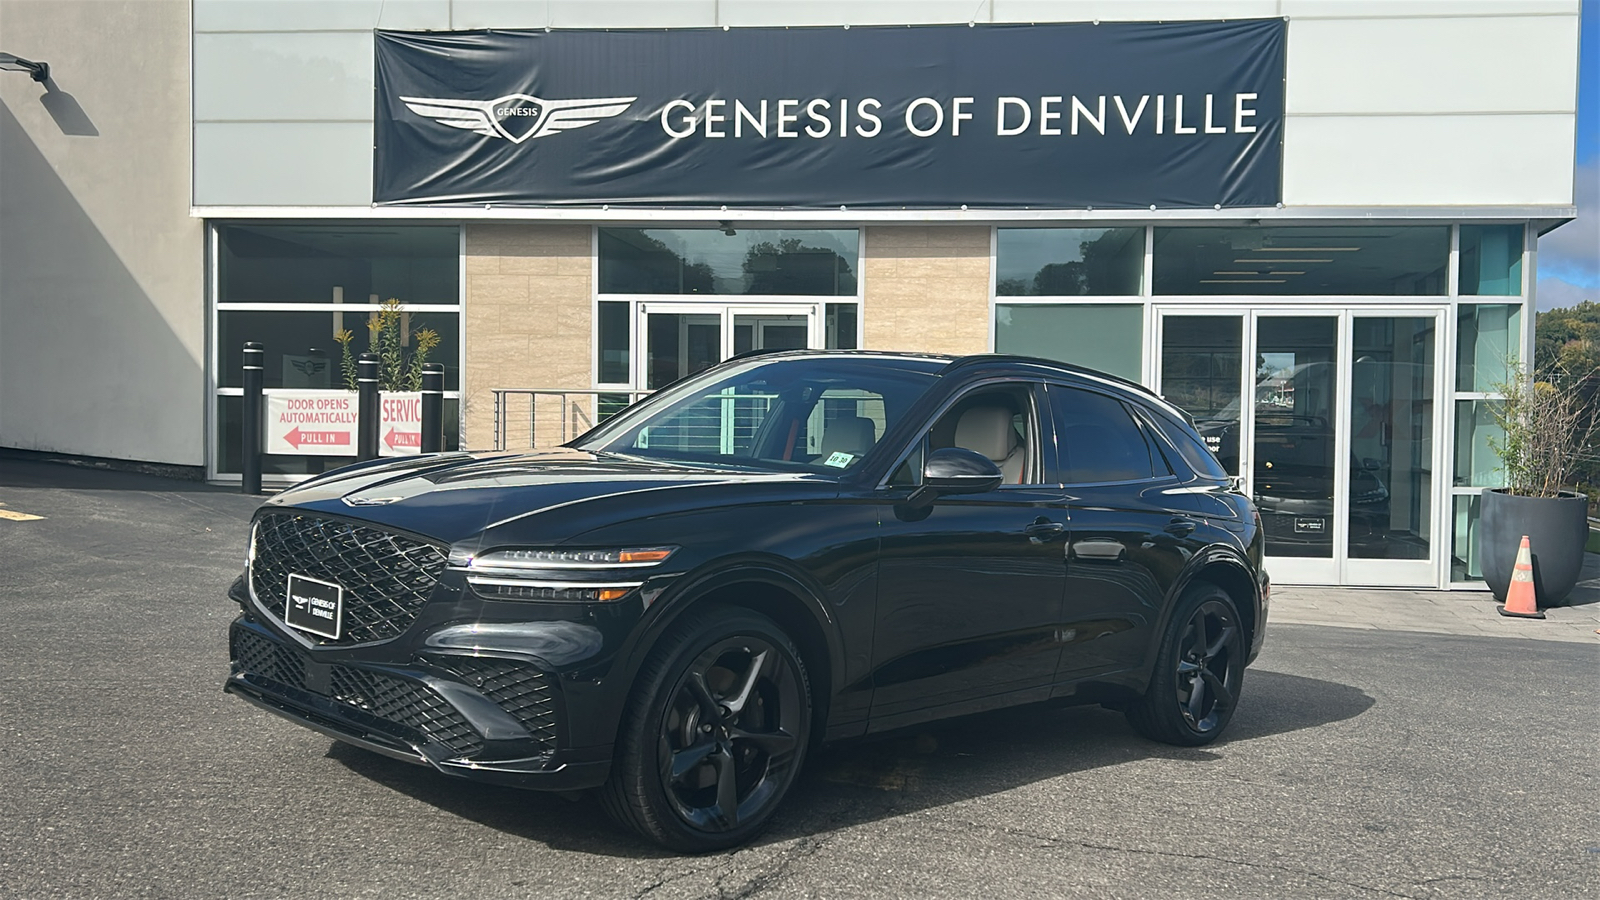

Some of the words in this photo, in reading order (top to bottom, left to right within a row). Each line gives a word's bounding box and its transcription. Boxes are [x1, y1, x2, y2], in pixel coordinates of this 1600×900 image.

[497, 107, 538, 117] GENESIS
[660, 98, 883, 139] GENESIS
[905, 97, 974, 137] OF
[997, 93, 1258, 136] DENVILLE
[287, 399, 315, 410] DOOR
[316, 399, 349, 410] OPENS
[382, 399, 421, 422] SERVIC
[279, 412, 357, 423] AUTOMATICALLY
[301, 432, 323, 443] PULL
[325, 433, 336, 443] IN
[394, 434, 408, 444] PULL
